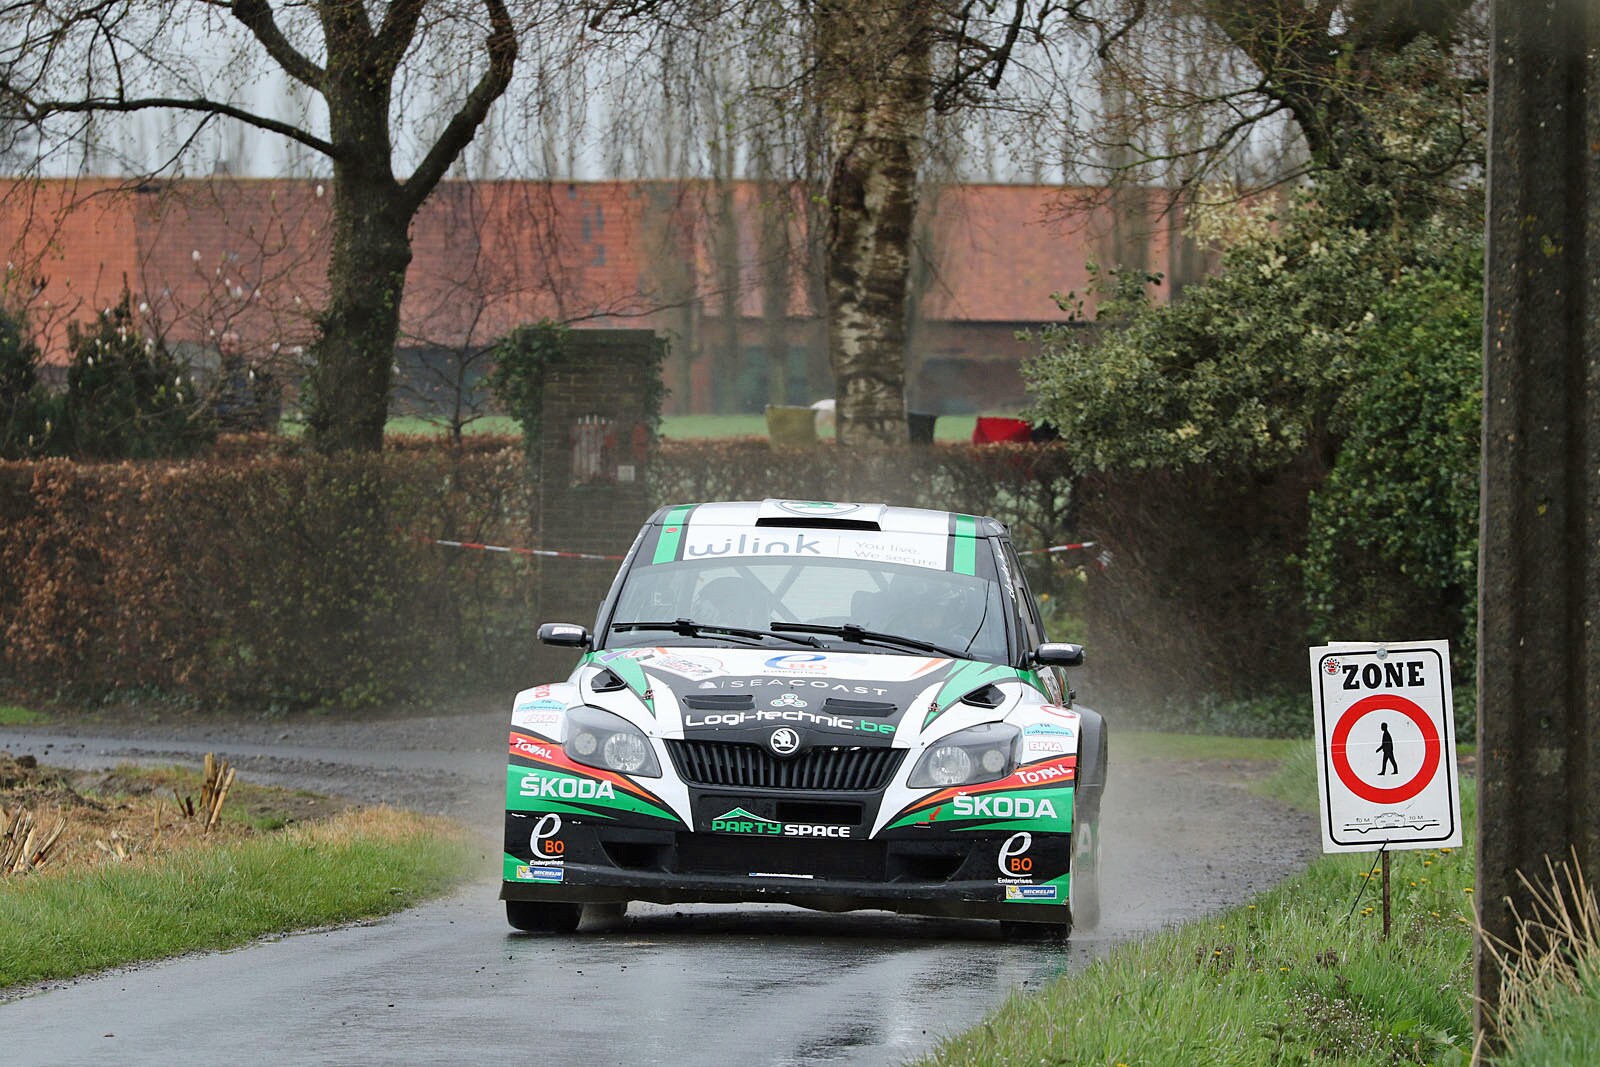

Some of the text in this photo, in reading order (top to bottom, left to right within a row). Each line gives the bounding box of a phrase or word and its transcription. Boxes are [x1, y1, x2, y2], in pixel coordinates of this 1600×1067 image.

[854, 550, 880, 559] We
[856, 541, 885, 551] You
[1342, 661, 1425, 690] ZONE
[730, 678, 888, 696] SEACOAST
[1029, 741, 1064, 752] BMA
[1015, 764, 1073, 784] TOTAL
[519, 772, 616, 799] ŠKODA
[953, 792, 1058, 818] ŠKODA
[711, 820, 850, 838] PARTY SPACE
